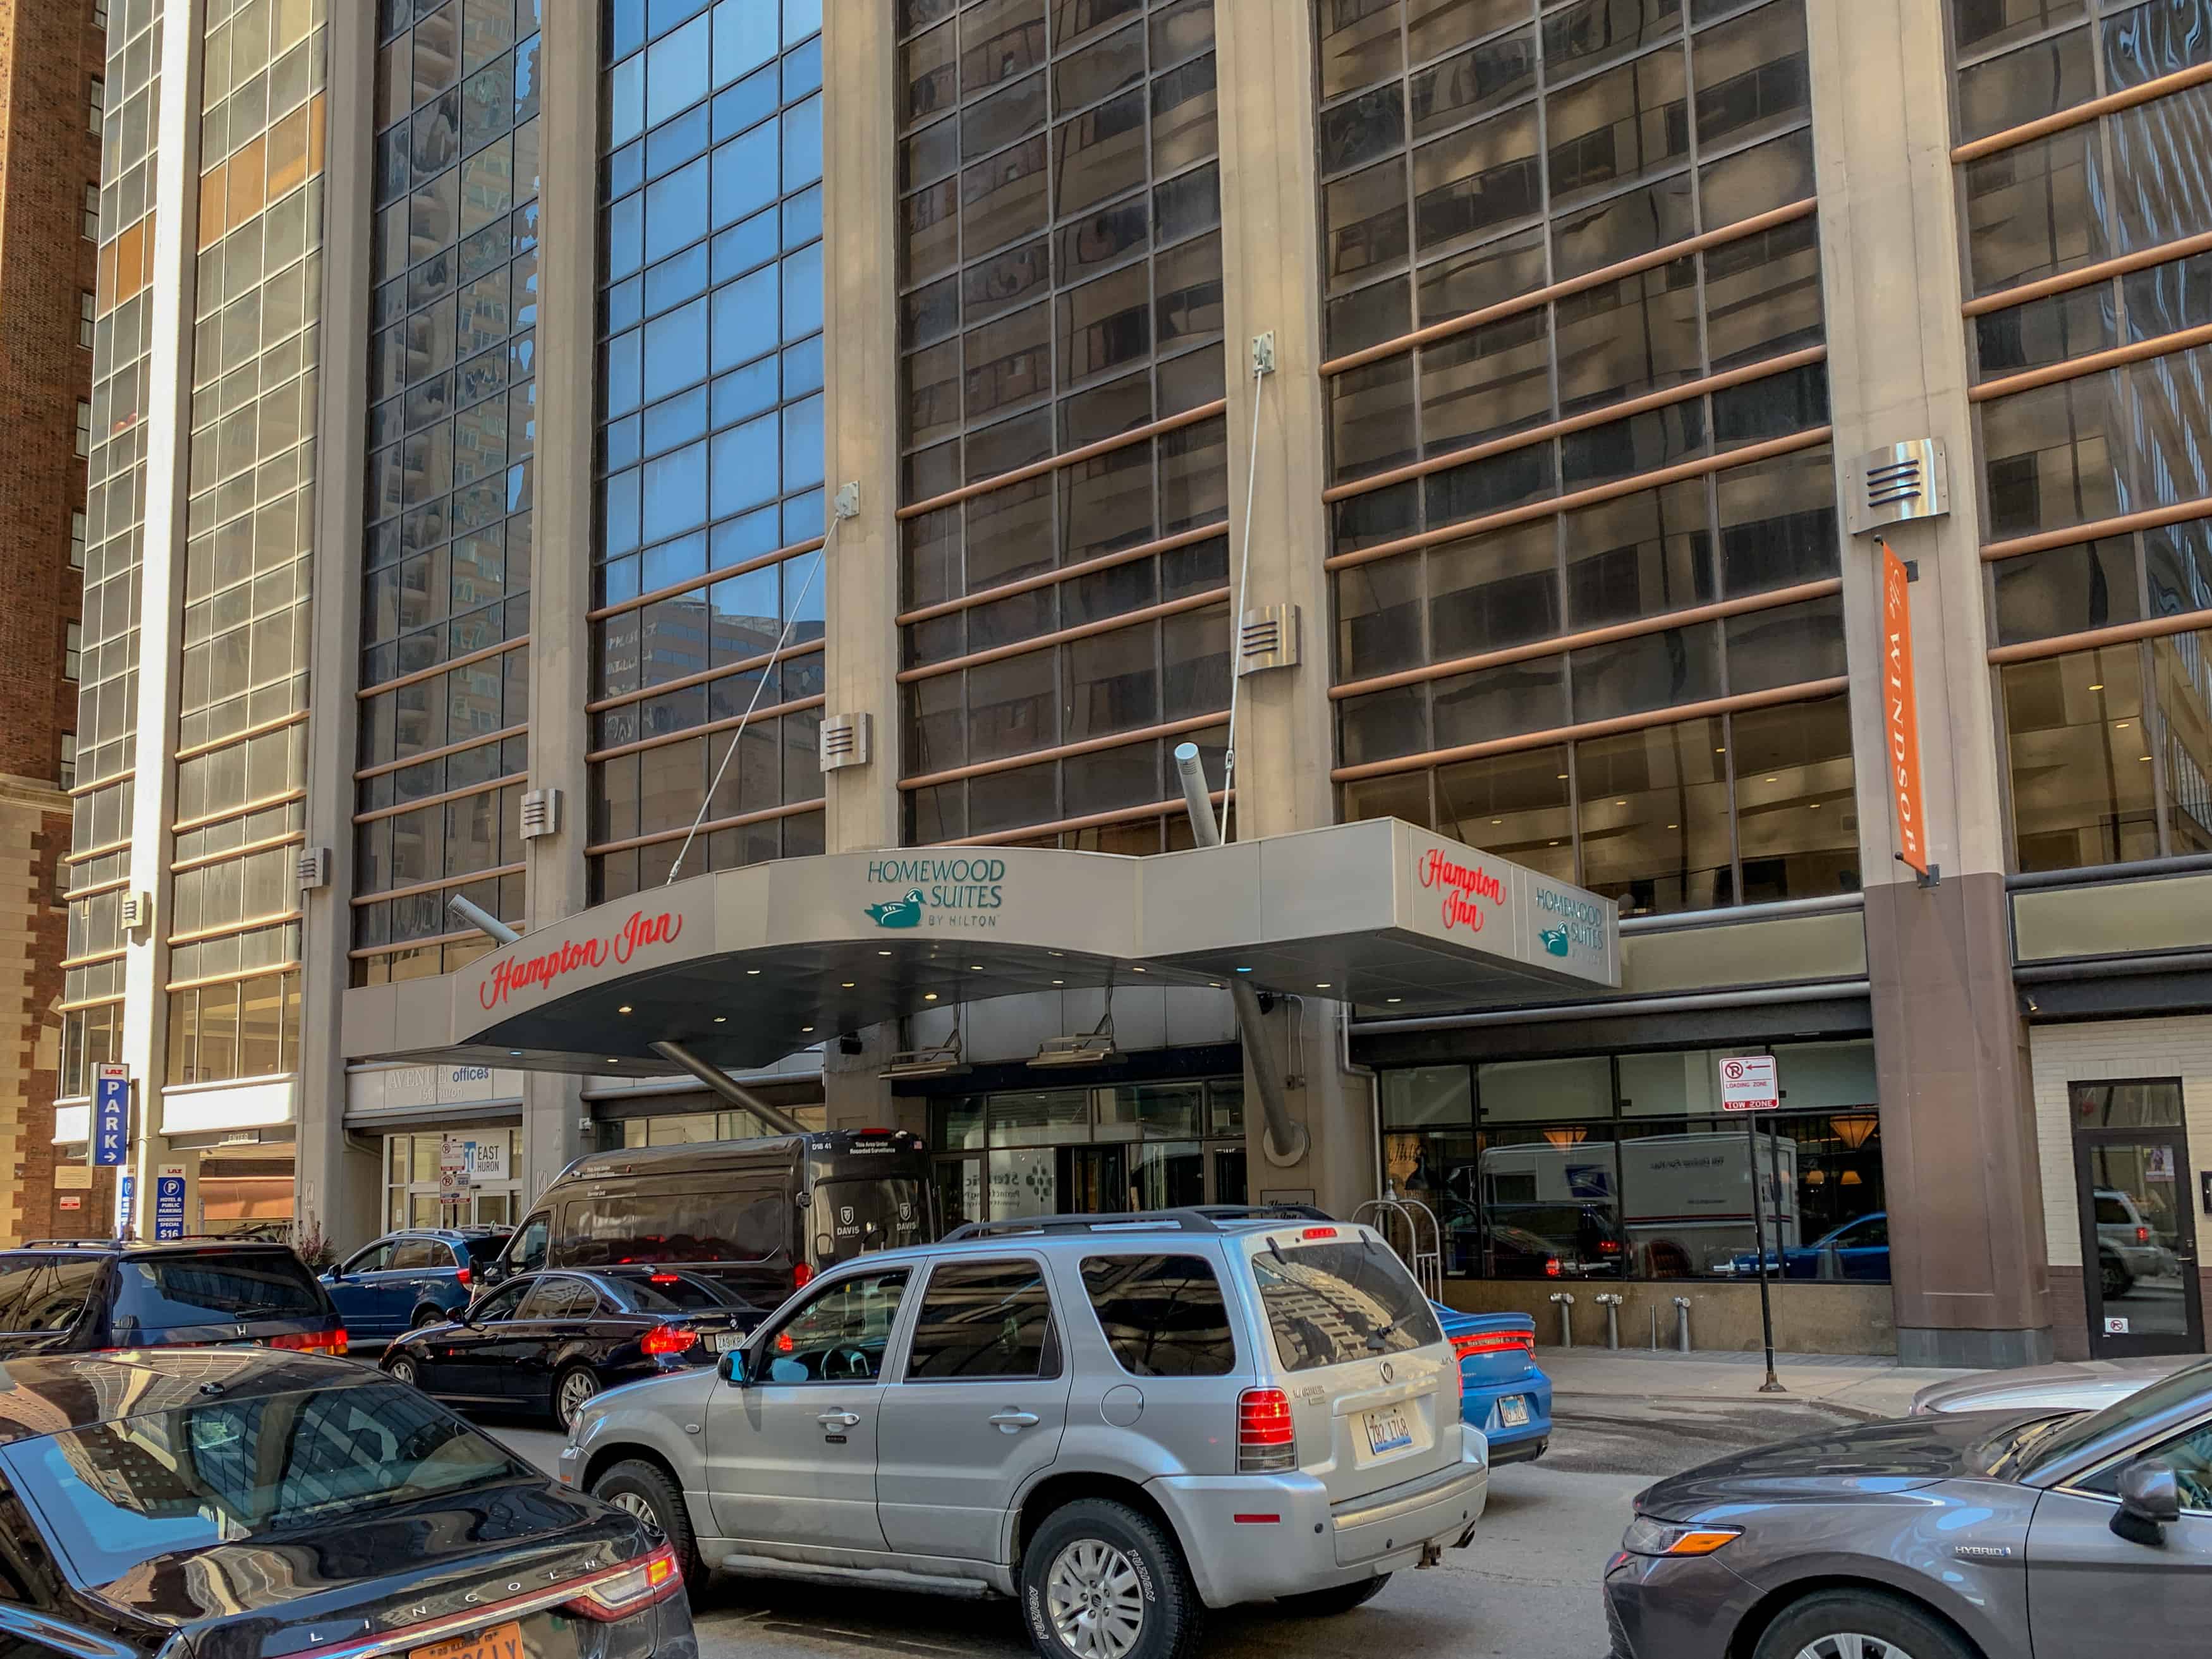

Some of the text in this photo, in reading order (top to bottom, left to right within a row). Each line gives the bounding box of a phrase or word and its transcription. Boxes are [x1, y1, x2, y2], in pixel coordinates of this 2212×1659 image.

[867, 859, 1006, 883] HOMEWOOD
[1418, 849, 1506, 906] Hampton
[930, 885, 1002, 908] SUITES
[1536, 887, 1602, 927] HOMEWOOD
[928, 915, 996, 927] BY HILTON
[1442, 890, 1484, 932] Inn
[1571, 921, 1603, 950] SUITES
[480, 911, 683, 1010] Hampton Inn
[453, 1067, 489, 1083] offices
[104, 1081, 121, 1149] PARK
[477, 1145, 499, 1160] EAST
[477, 1161, 499, 1172] HURON
[837, 1226, 860, 1236] DAVIS
[897, 1222, 916, 1231] DAVIS
[1955, 1546, 2003, 1556] HYBRID
[310, 1559, 596, 1643] LINCOLN
